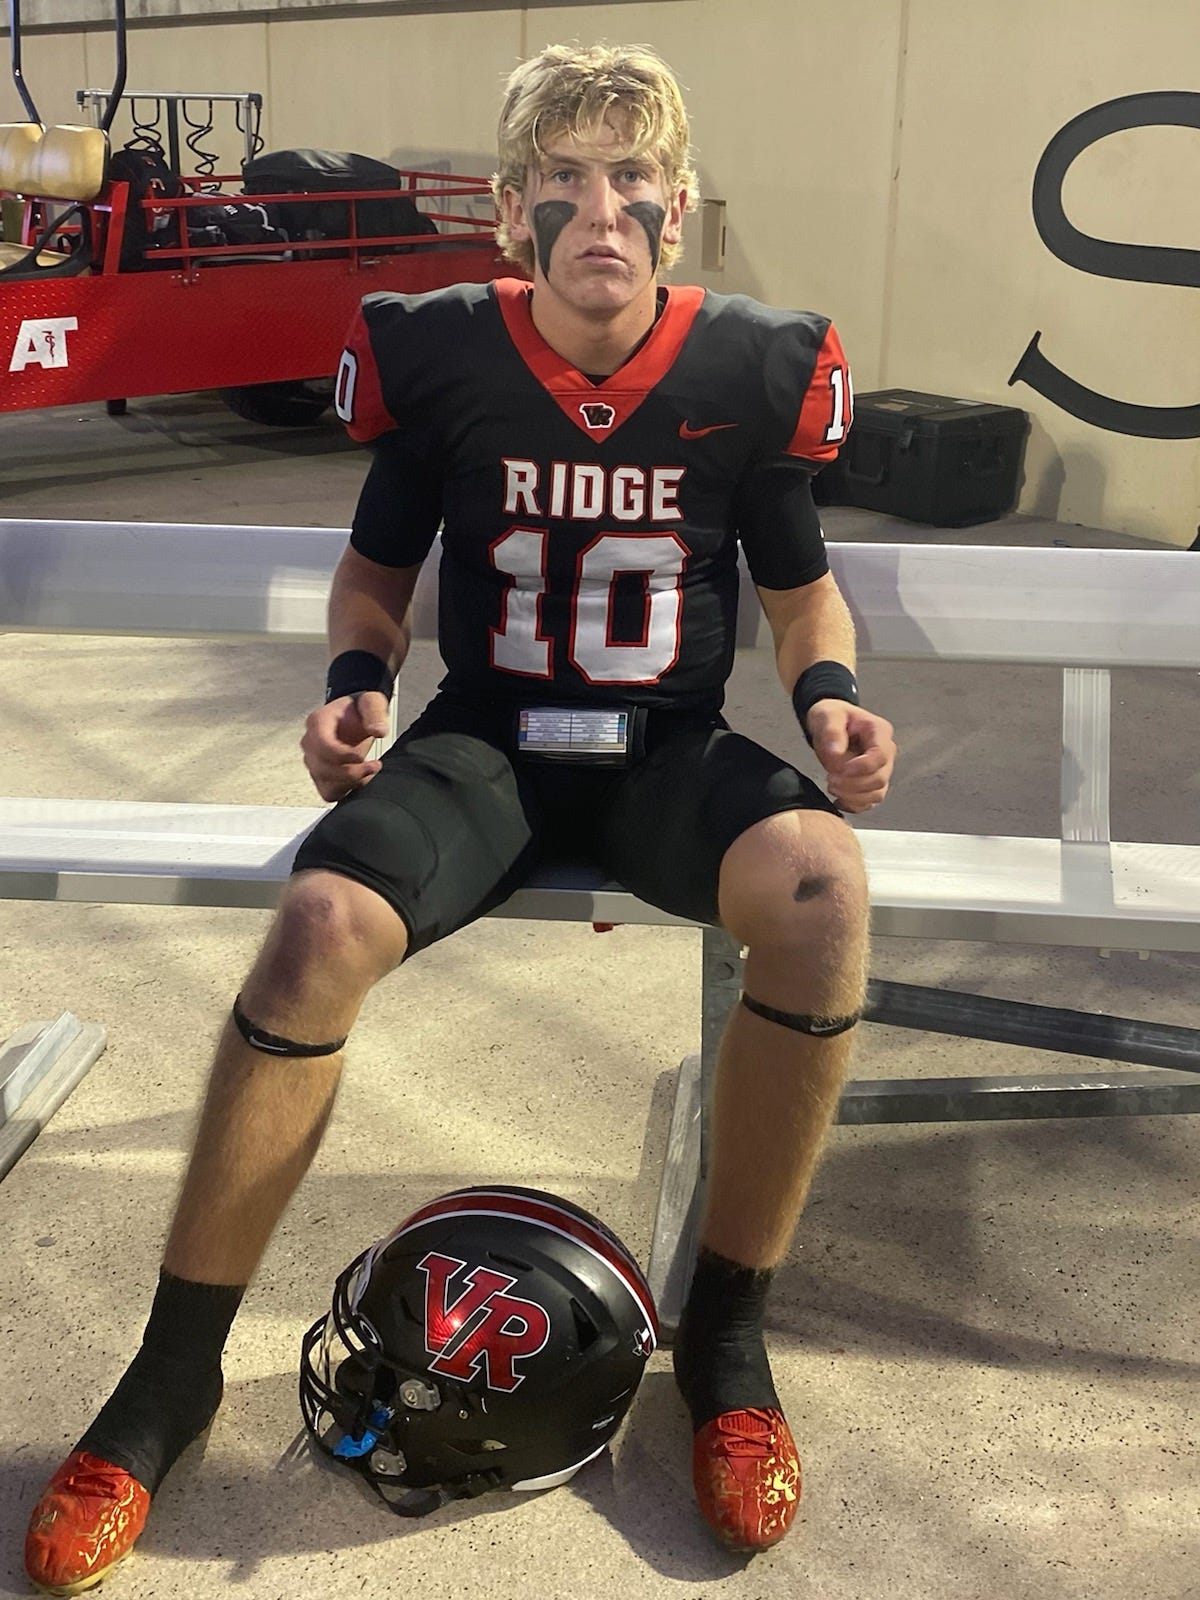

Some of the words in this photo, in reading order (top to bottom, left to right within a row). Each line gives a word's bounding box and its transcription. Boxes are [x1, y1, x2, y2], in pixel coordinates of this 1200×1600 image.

[9, 316, 78, 372] AT
[824, 365, 854, 442] 1
[502, 457, 687, 522] RIDGE
[489, 525, 693, 685] 10
[416, 1251, 550, 1393] VR
